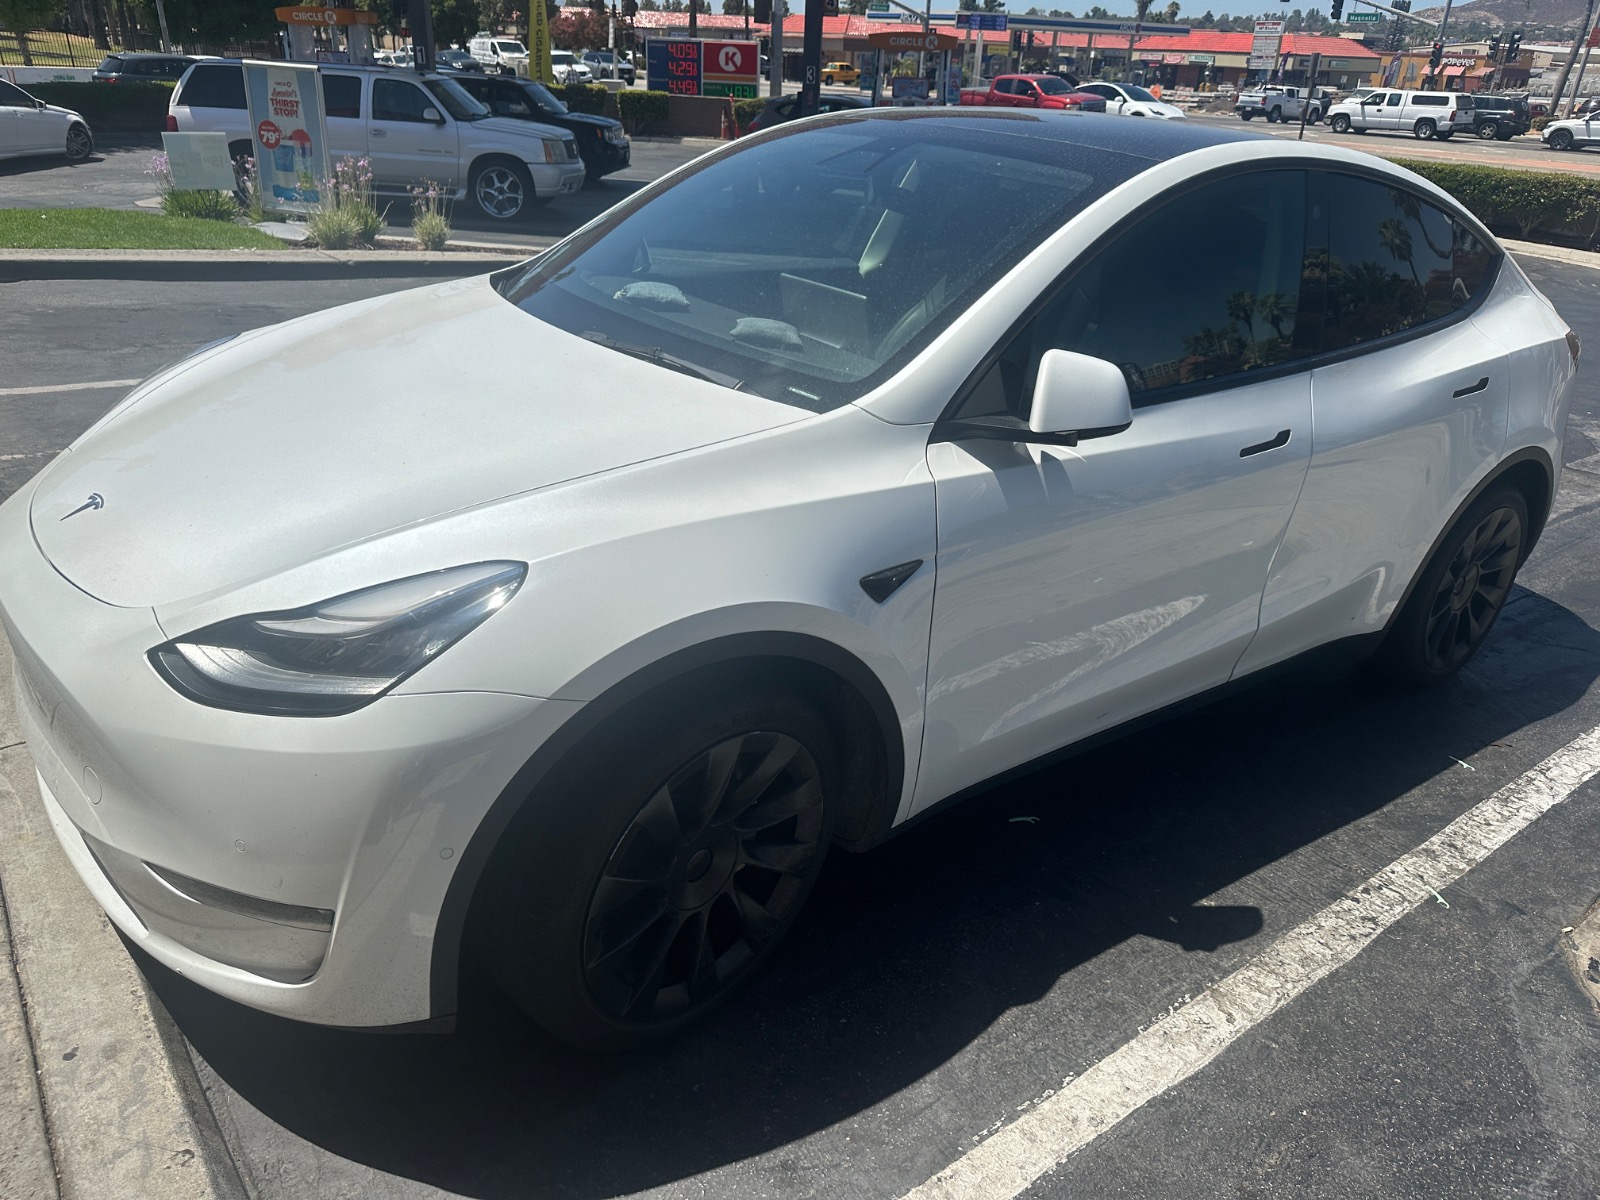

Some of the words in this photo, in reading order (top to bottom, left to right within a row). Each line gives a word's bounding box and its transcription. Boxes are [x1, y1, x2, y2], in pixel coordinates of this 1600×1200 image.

[292, 12, 324, 21] CIRCLE
[324, 11, 336, 24] K
[889, 37, 923, 46] CIRCLE
[925, 35, 938, 49] K
[417, 46, 425, 63] 1
[721, 48, 741, 71] K
[1443, 57, 1476, 67] POPEYES
[807, 66, 815, 83] 3
[270, 97, 300, 109] THIRST
[274, 108, 298, 118] STOP!
